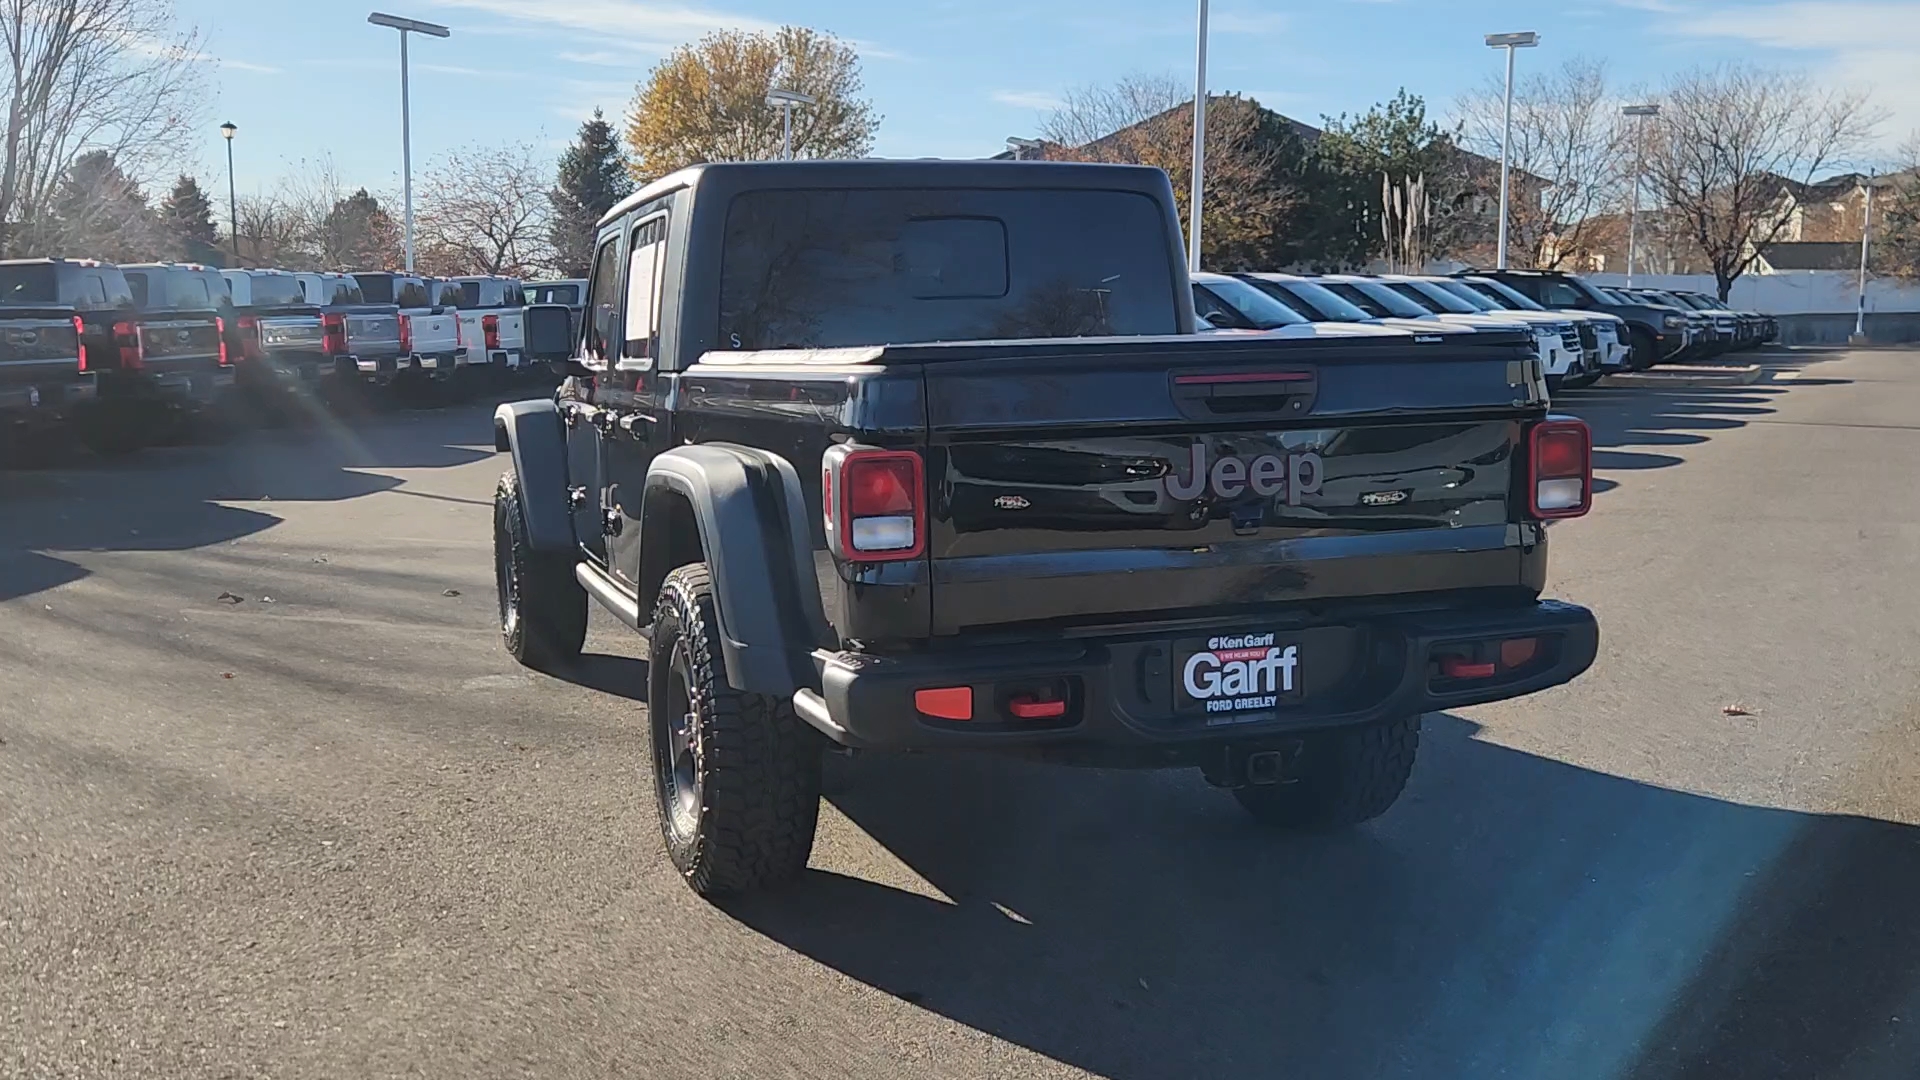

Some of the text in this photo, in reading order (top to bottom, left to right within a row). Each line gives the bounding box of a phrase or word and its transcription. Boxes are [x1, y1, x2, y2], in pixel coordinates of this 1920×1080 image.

[1165, 443, 1324, 505] Jeep
[1219, 633, 1275, 649] Ken Garff
[1183, 646, 1298, 699] Garff
[1206, 696, 1277, 712] FORD GREELEY
